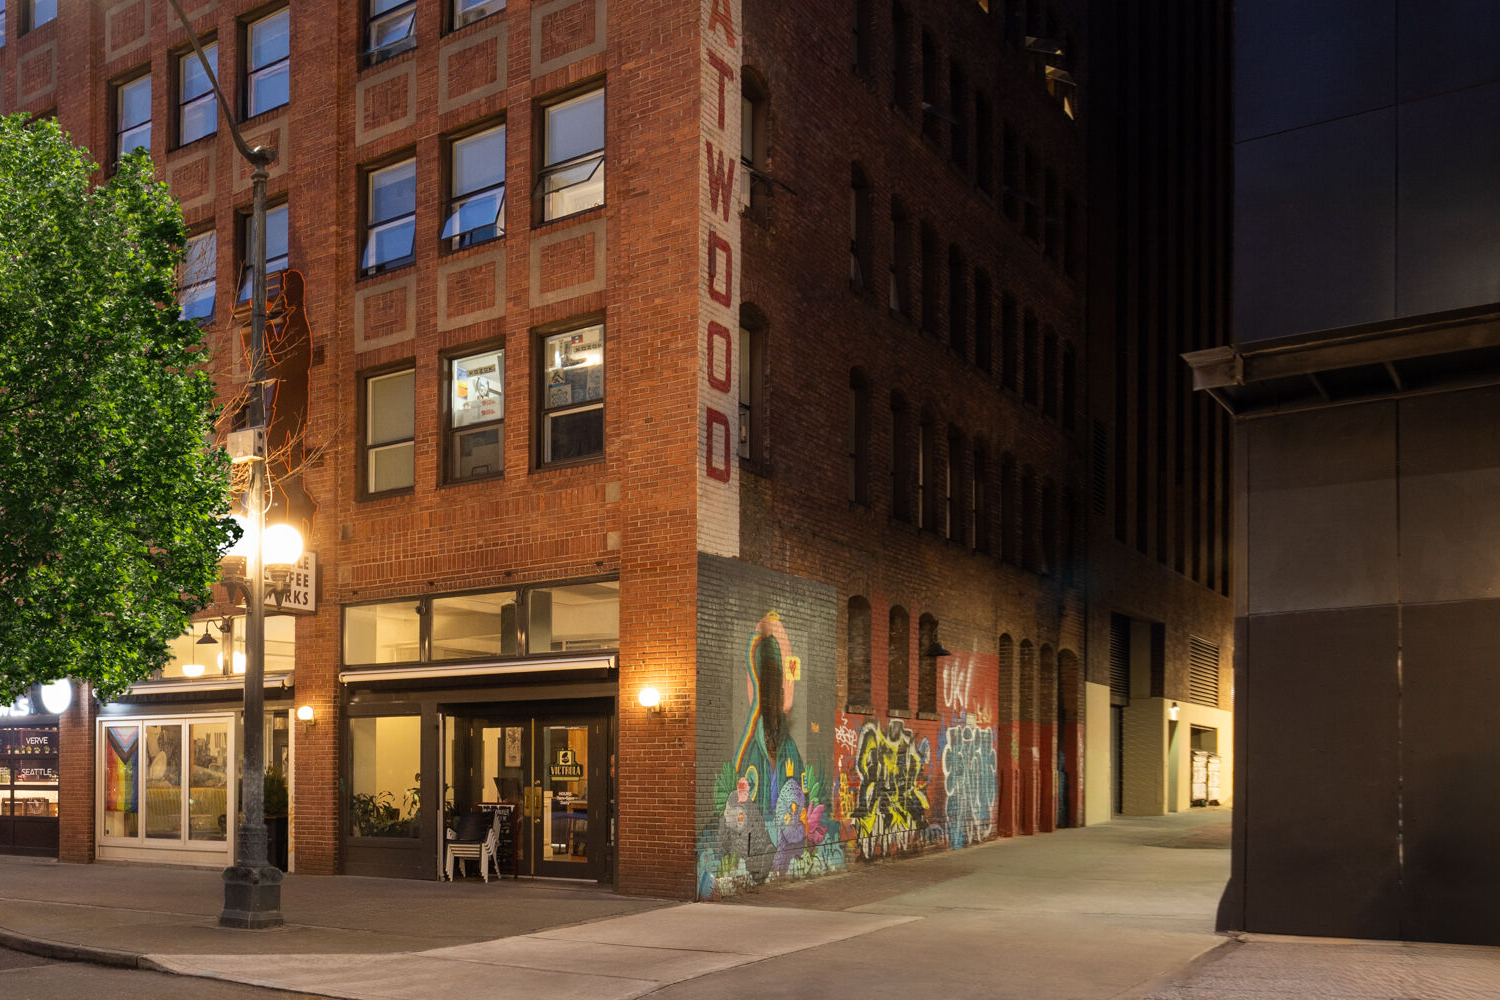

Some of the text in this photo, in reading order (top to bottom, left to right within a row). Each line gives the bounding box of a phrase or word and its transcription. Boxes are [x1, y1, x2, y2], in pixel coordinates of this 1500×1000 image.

[26, 736, 48, 745] VERVE
[21, 768, 52, 776] SEATTLE
[550, 766, 581, 776] VICTROLA
